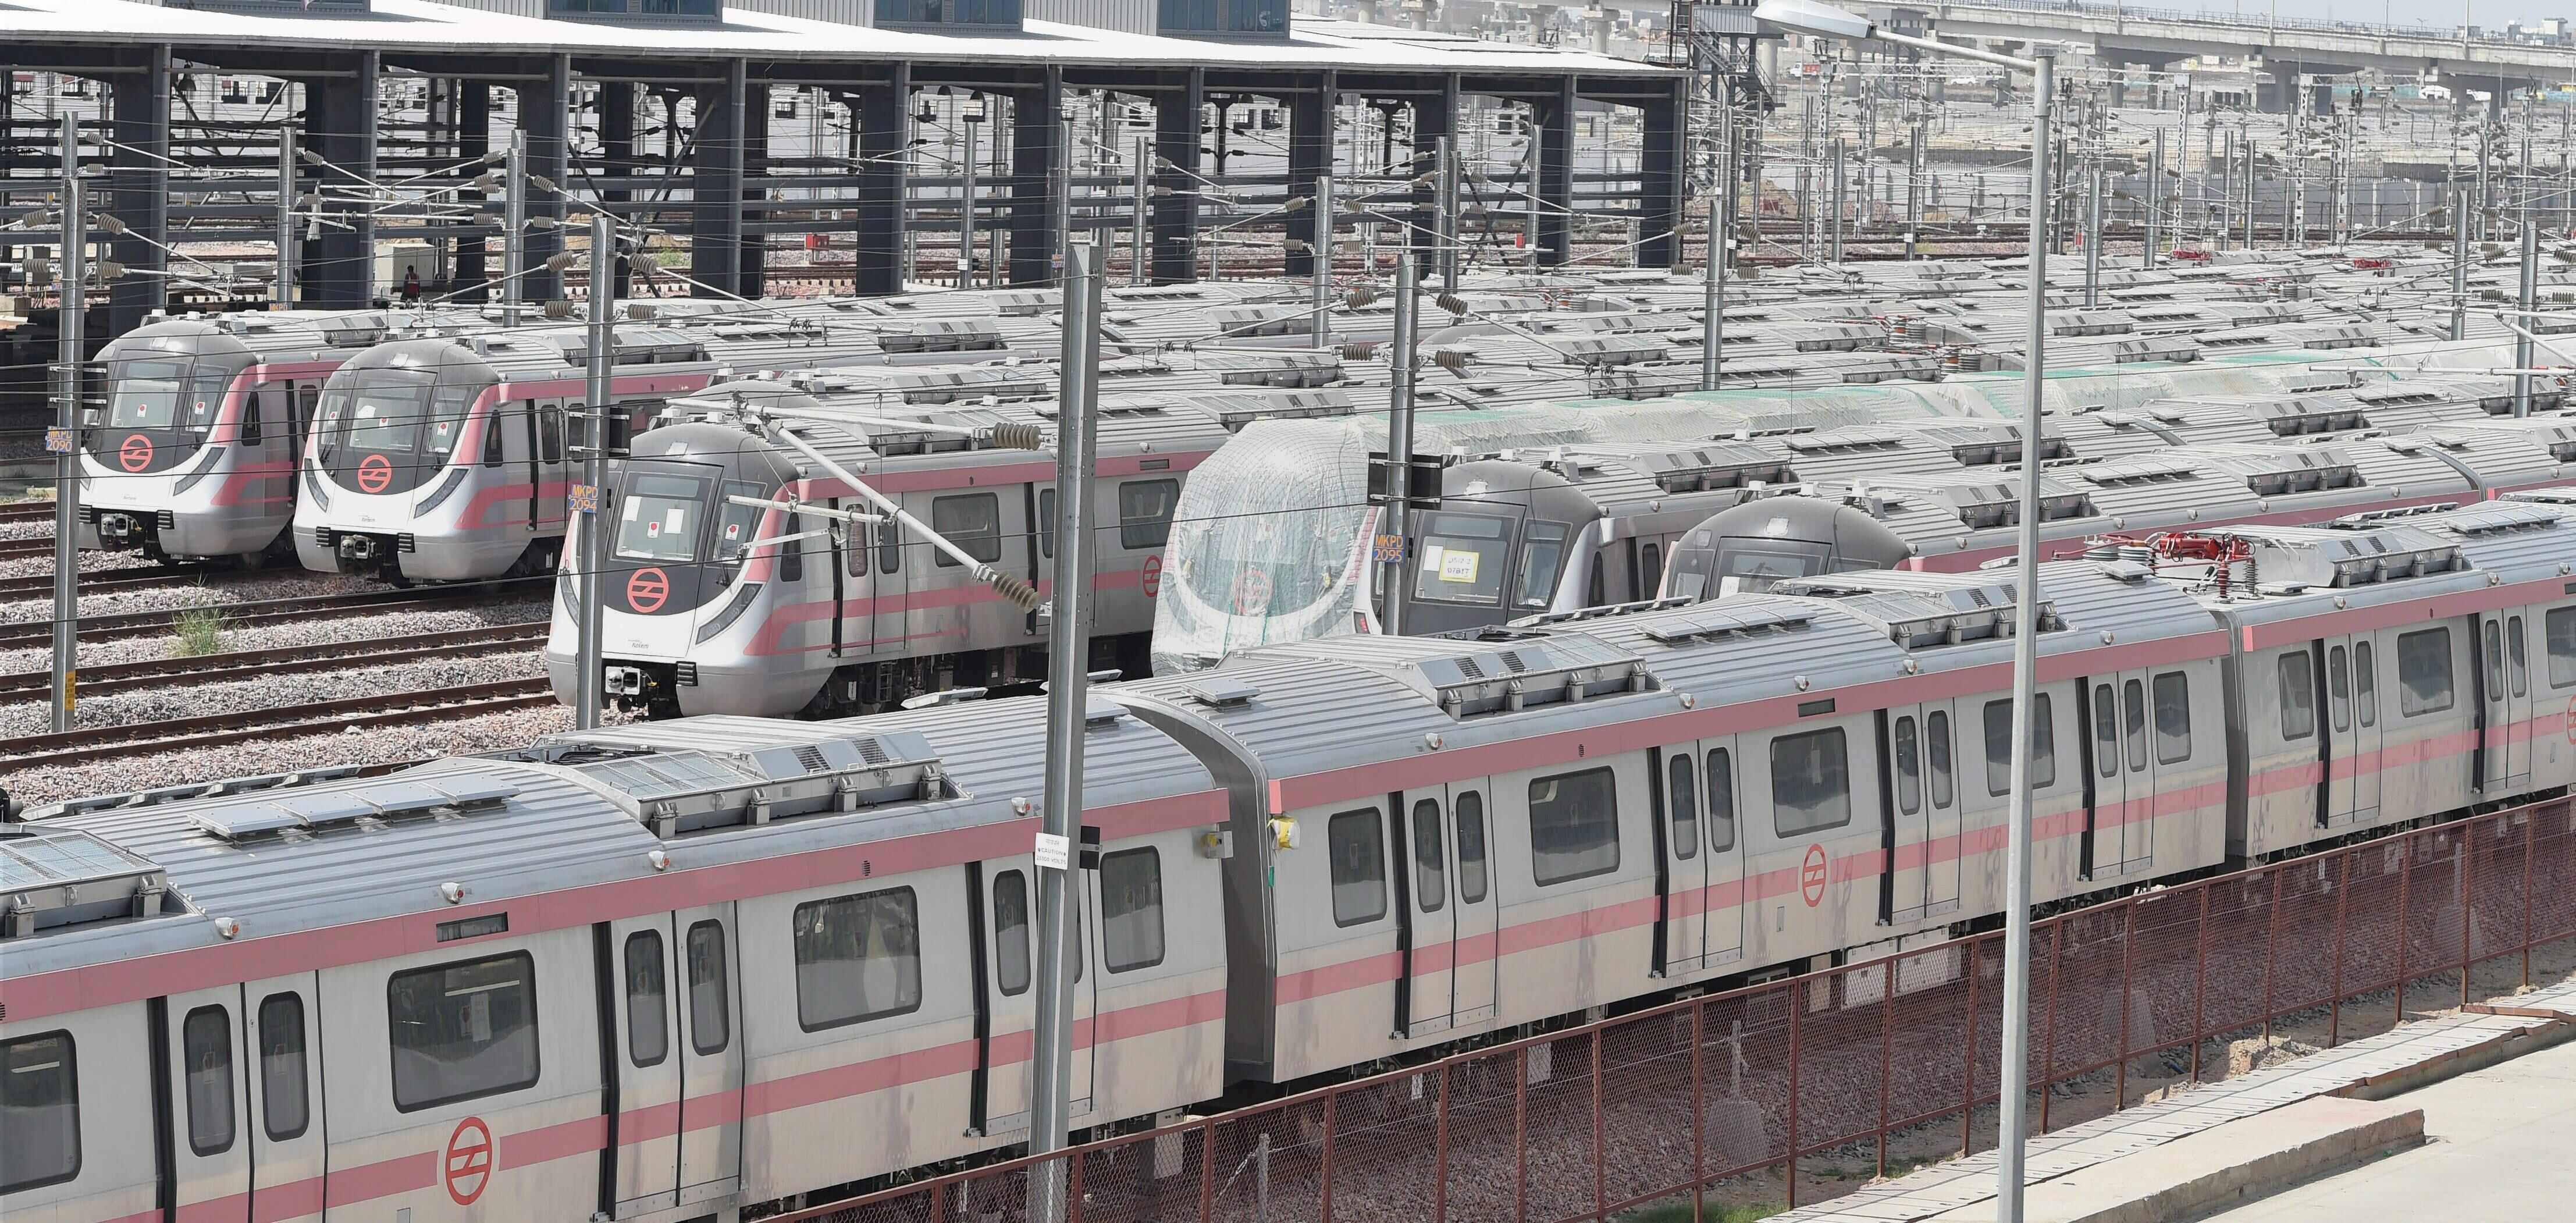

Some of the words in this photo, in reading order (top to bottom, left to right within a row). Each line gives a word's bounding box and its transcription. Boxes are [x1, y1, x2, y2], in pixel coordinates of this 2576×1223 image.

[48, 428, 72, 438] MKPD
[46, 440, 72, 452] 2090
[572, 484, 598, 498] MKPD
[570, 499, 597, 513] 2094
[1375, 534, 1403, 548] MKPD
[1374, 549, 1402, 562] 2095
[1041, 847, 1063, 856] CAUTION
